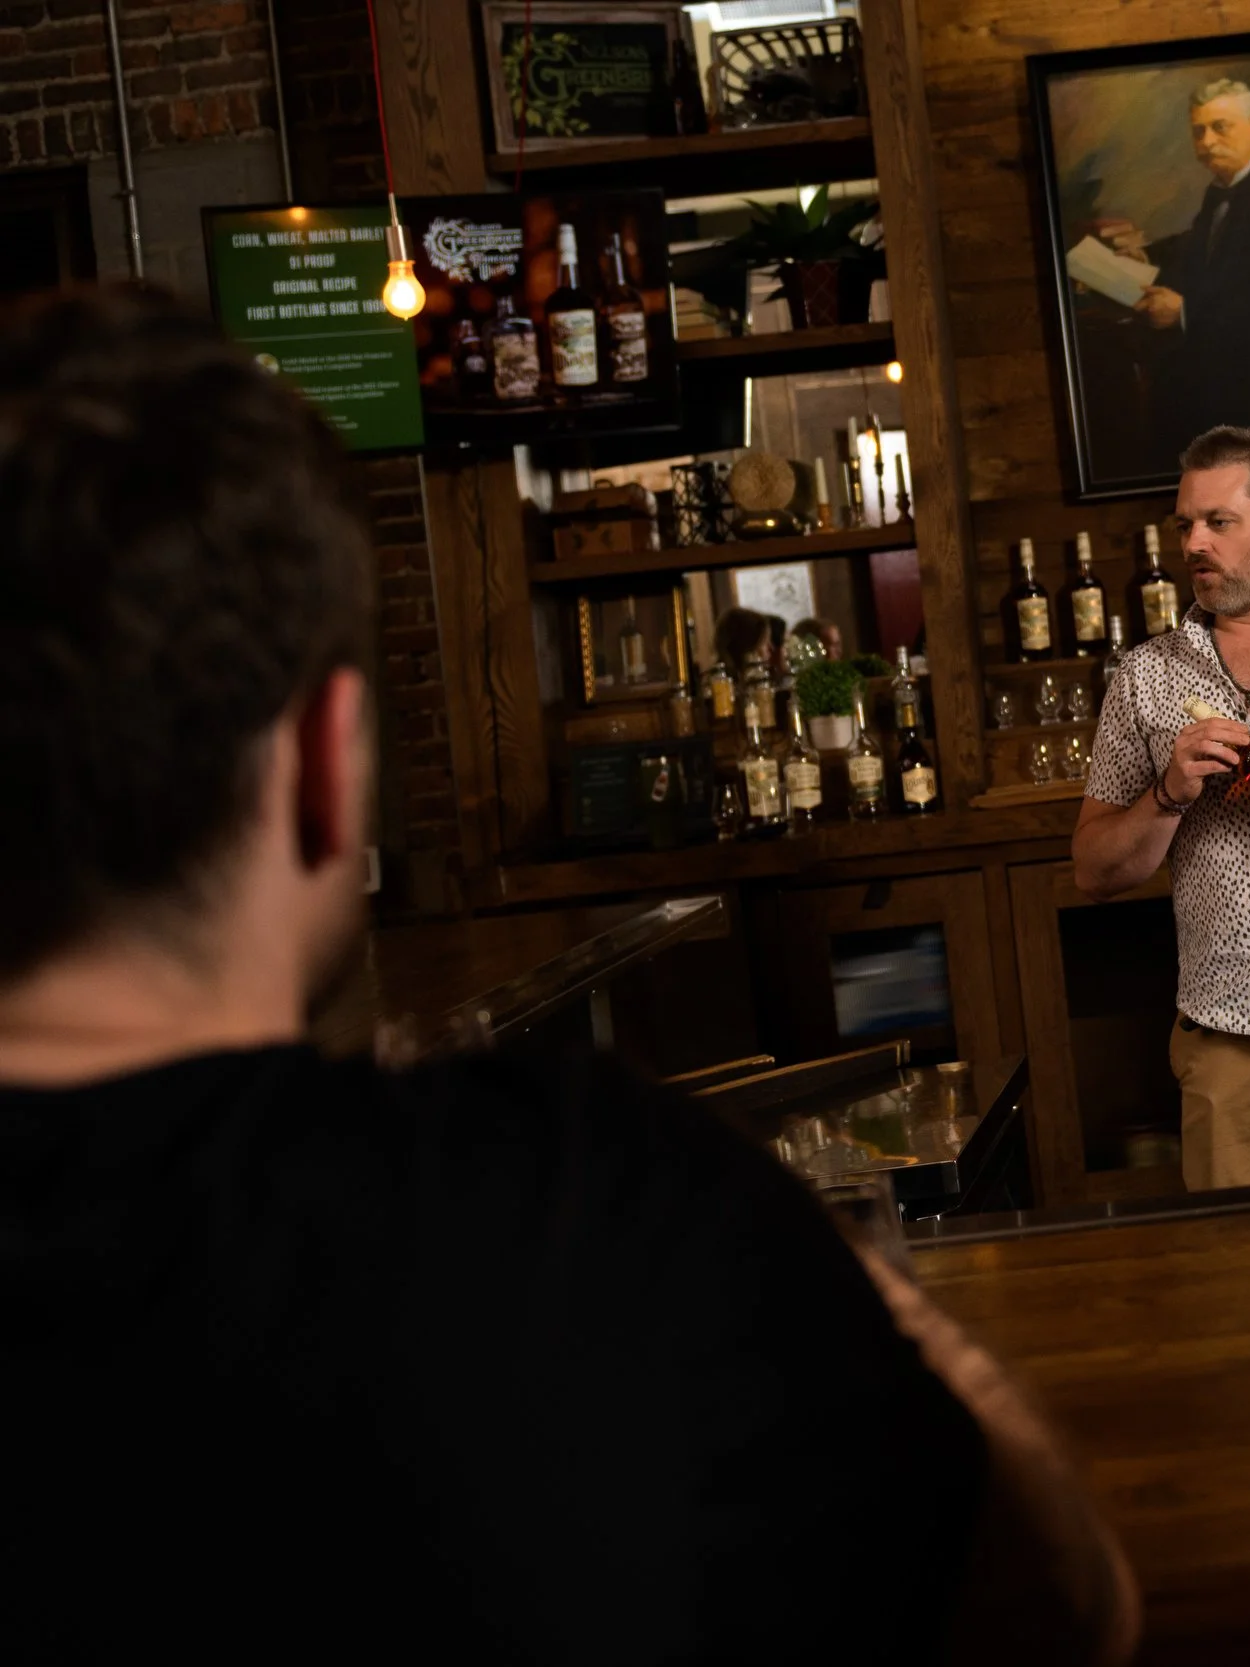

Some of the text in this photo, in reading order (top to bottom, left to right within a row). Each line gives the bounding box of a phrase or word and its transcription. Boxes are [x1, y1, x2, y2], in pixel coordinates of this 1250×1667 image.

[308, 228, 347, 244] MALTED
[303, 253, 336, 268] PROOF
[273, 276, 357, 295] ORIGINAL RECIPE
[247, 305, 276, 320] FIRST
[279, 302, 327, 319] BOTTLING
[329, 300, 360, 316] SINCE
